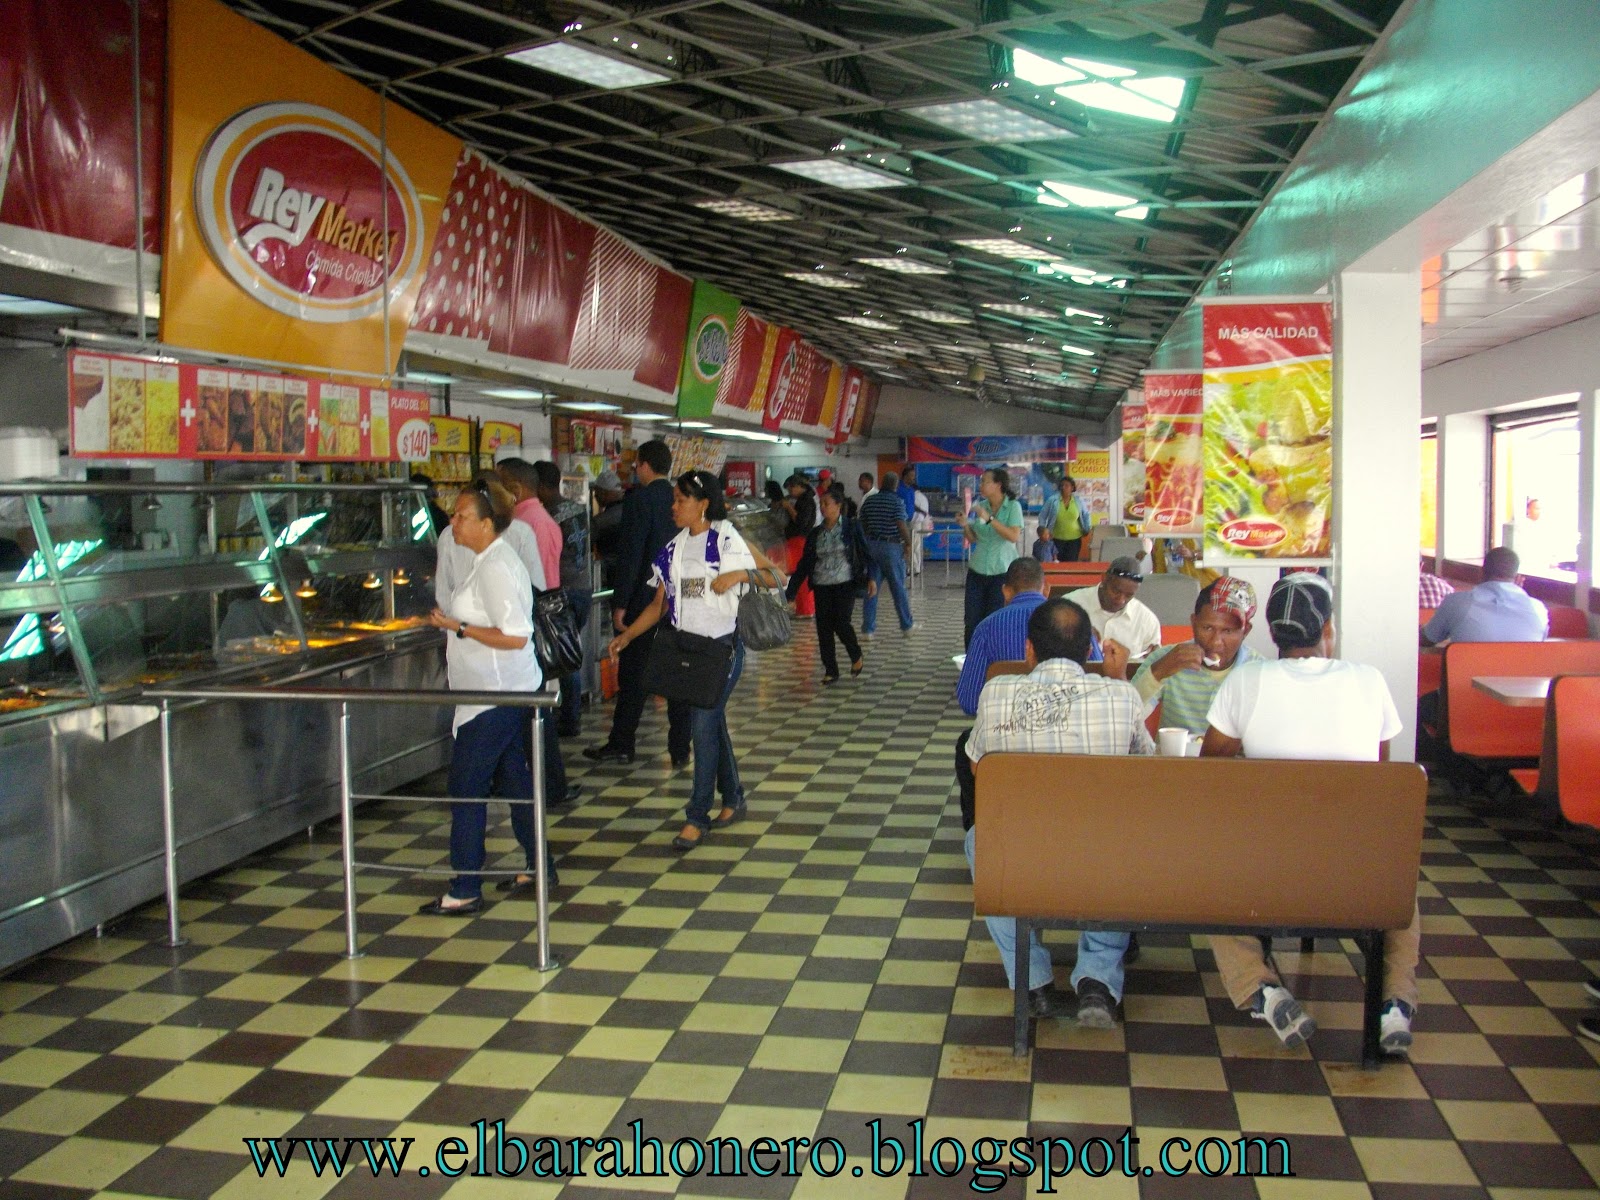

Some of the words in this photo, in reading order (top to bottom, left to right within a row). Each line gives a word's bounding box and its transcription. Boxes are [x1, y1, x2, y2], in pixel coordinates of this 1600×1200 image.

[243, 167, 326, 247] Rey
[317, 201, 399, 265] Market
[1218, 324, 1250, 340] MÁS
[1253, 326, 1319, 339] CALIDAD
[403, 429, 429, 458] $140
[1071, 465, 1109, 474] COMBO
[1072, 458, 1109, 466] XPRES
[1226, 528, 1251, 541] Rey
[1023, 685, 1080, 712] ATHLETIC
